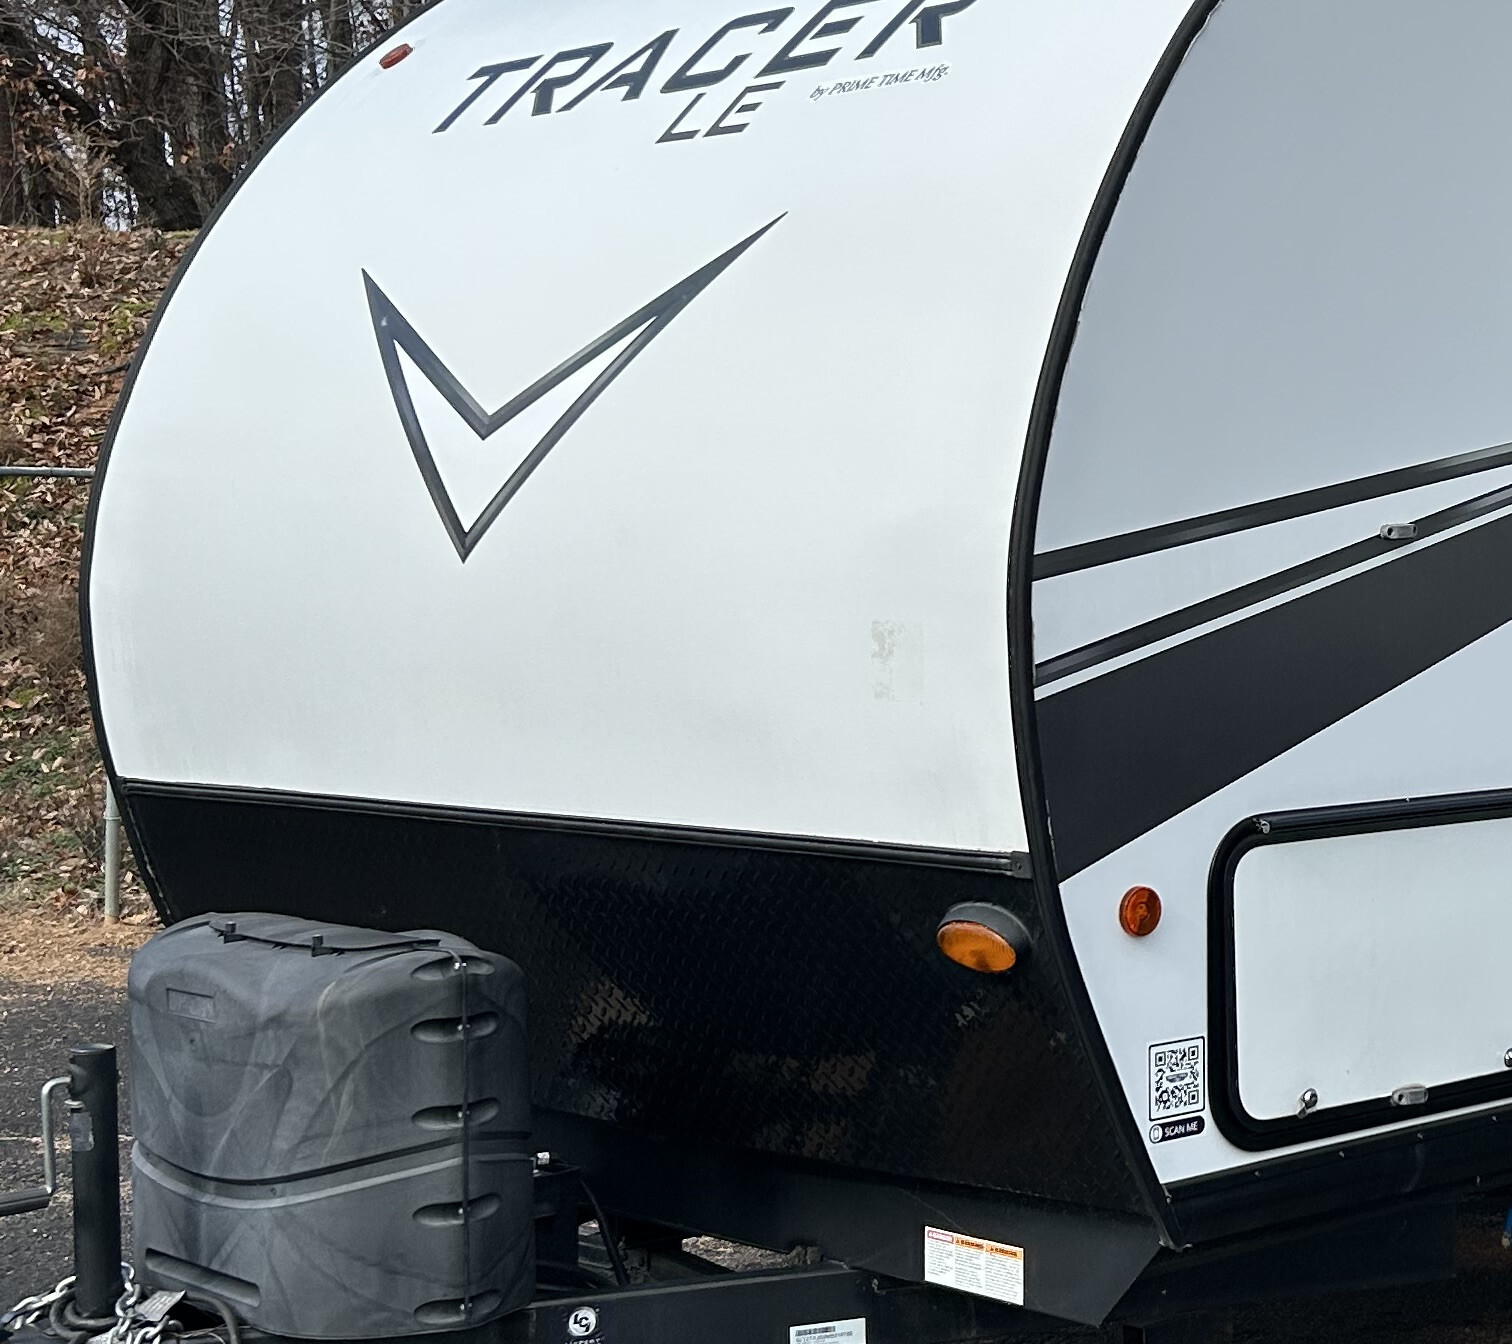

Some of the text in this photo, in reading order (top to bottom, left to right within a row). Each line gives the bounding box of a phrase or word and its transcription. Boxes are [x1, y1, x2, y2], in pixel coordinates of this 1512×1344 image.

[828, 76, 880, 95] PRIME
[877, 69, 919, 92] TIME
[655, 81, 784, 144] LE
[1165, 1121, 1198, 1137] SCAN ME
